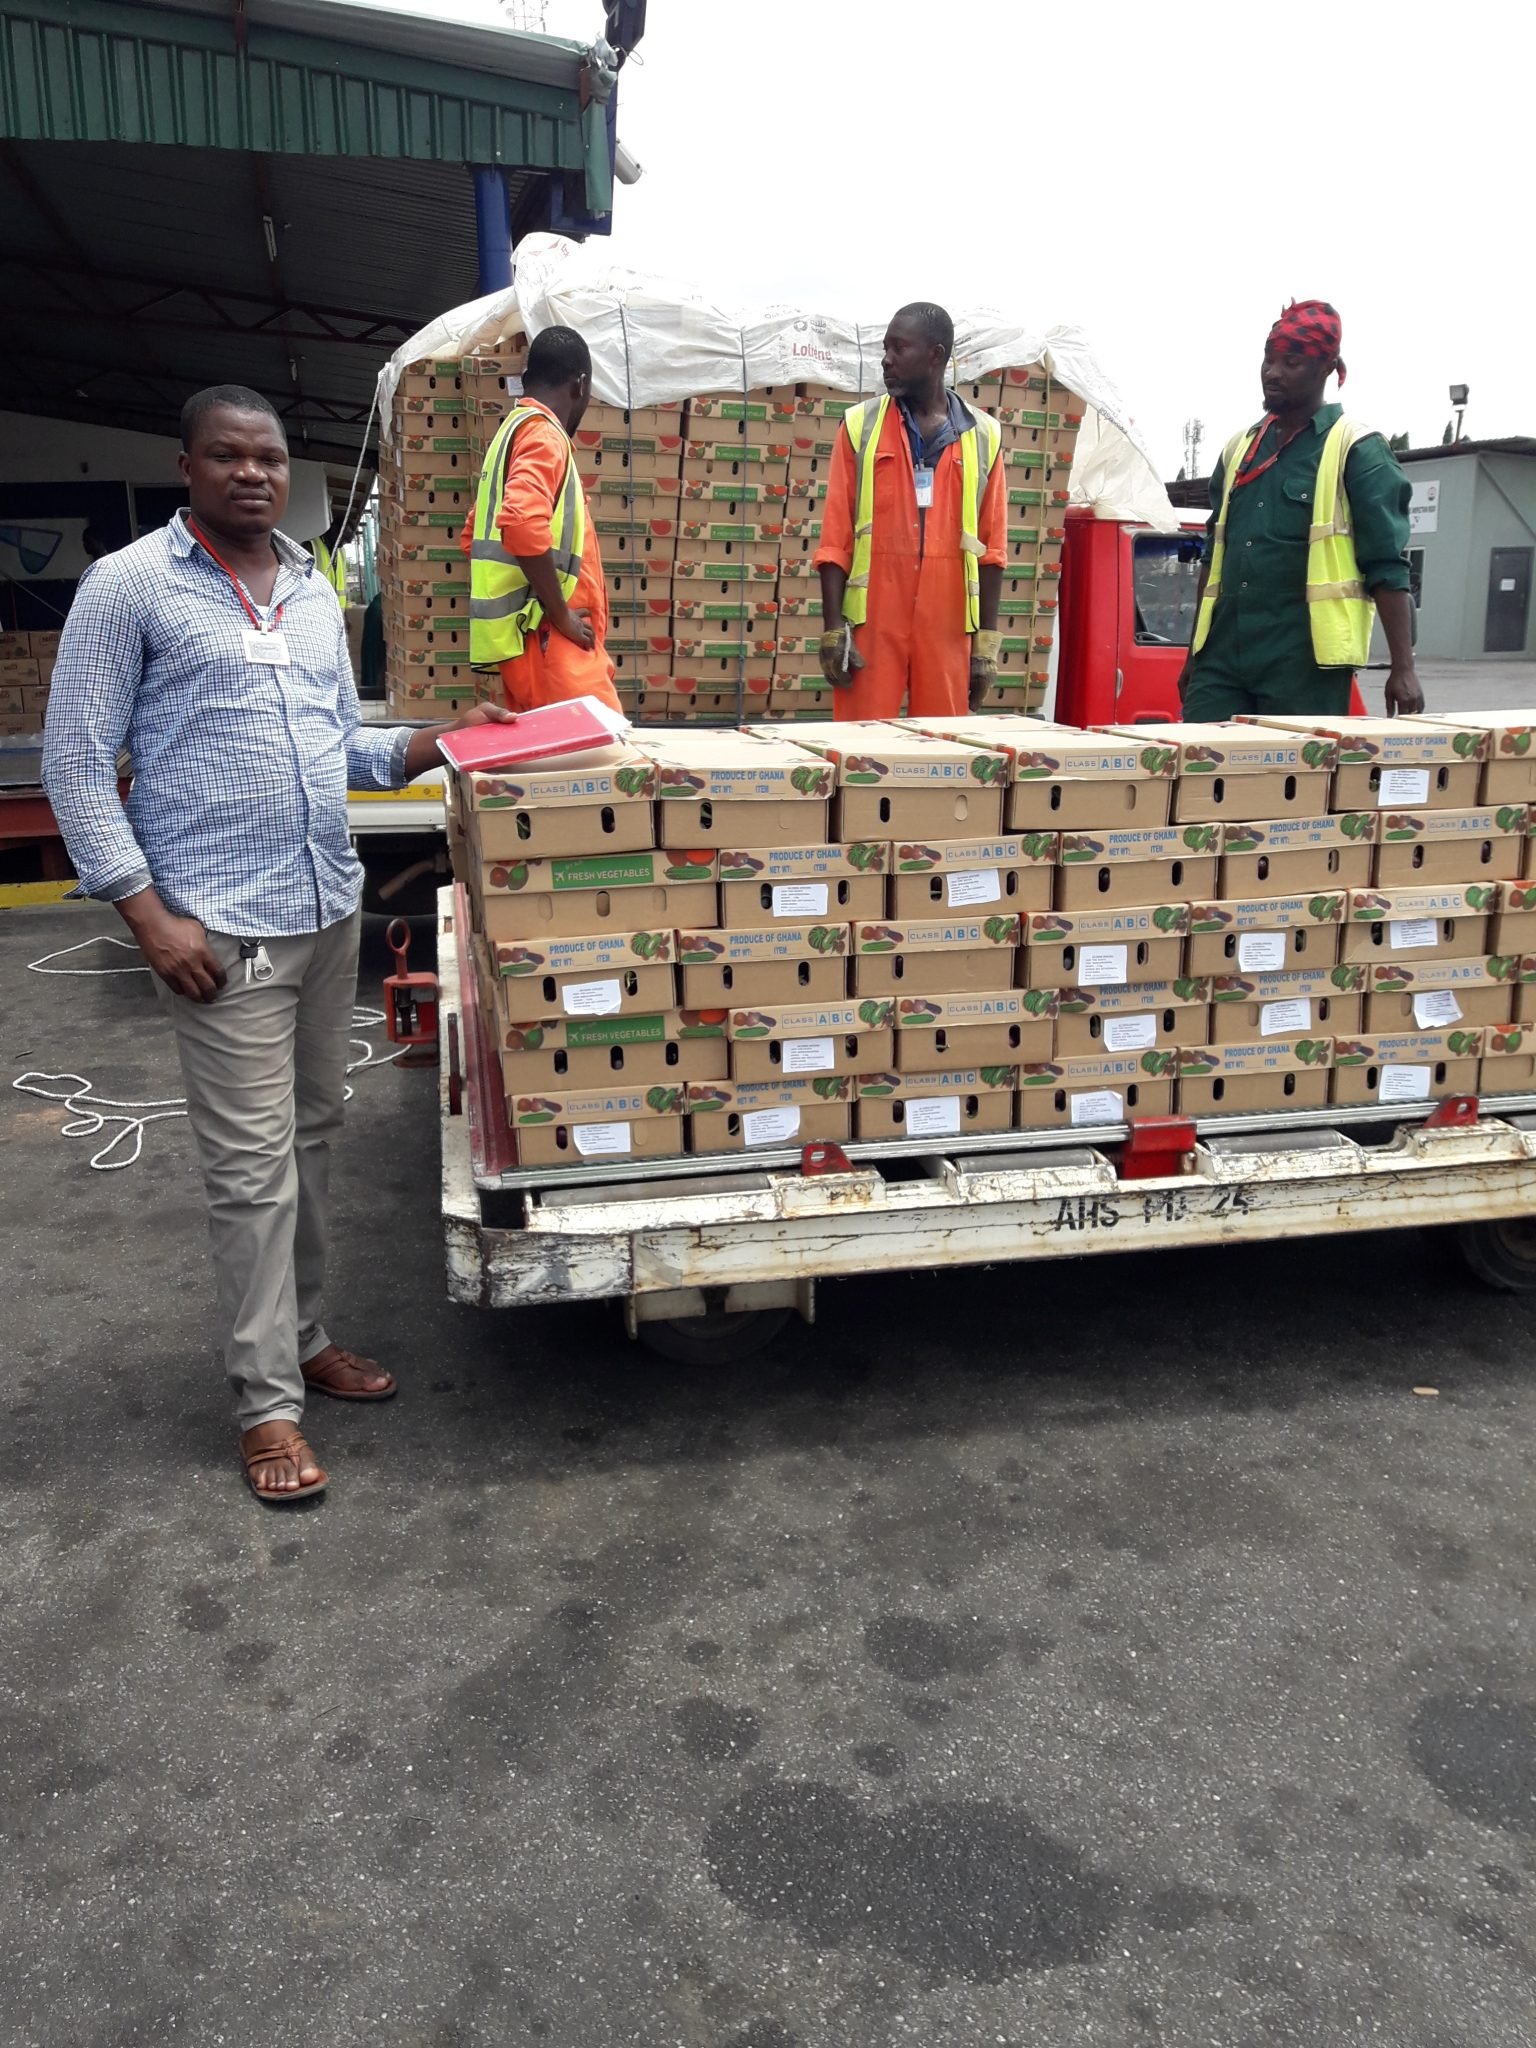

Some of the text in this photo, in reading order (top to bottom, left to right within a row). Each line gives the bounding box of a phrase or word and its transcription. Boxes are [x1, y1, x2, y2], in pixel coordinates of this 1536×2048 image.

[1383, 736, 1447, 746] PRODUCE OF GHANA
[710, 770, 785, 780] PRODUCE OF GHANA
[533, 784, 566, 795] CLASS
[1269, 819, 1335, 833] PRODUCE OF GHANA
[1109, 830, 1177, 843] PRODUCE OF GHANA
[769, 849, 842, 861] PRODUCE OF GHANA
[568, 868, 650, 882] FRESH VEGETABLES
[1237, 900, 1303, 913] PRODUCE OF GHANA
[1080, 921, 1109, 929] CLASS
[729, 931, 801, 945] PRODUCE OF GHANA
[910, 932, 940, 940] CLASS
[549, 938, 625, 955] PRODUCE OF GHANA
[1259, 970, 1325, 984] PRODUCE OF GHANA
[1101, 981, 1168, 995] PRODUCE OF GHANA
[784, 1017, 814, 1025] CLASS
[581, 1028, 661, 1042] FRESH VEGETABLES
[1378, 1035, 1442, 1048] PRODUCE OF GHANA
[1224, 1044, 1290, 1058] PRODUCE OF GHANA
[1070, 1066, 1099, 1074] CLASS
[736, 1079, 807, 1092] PRODUCE OF GHANA
[569, 1103, 600, 1111] CLASS
[1054, 1197, 1120, 1231] AHS
